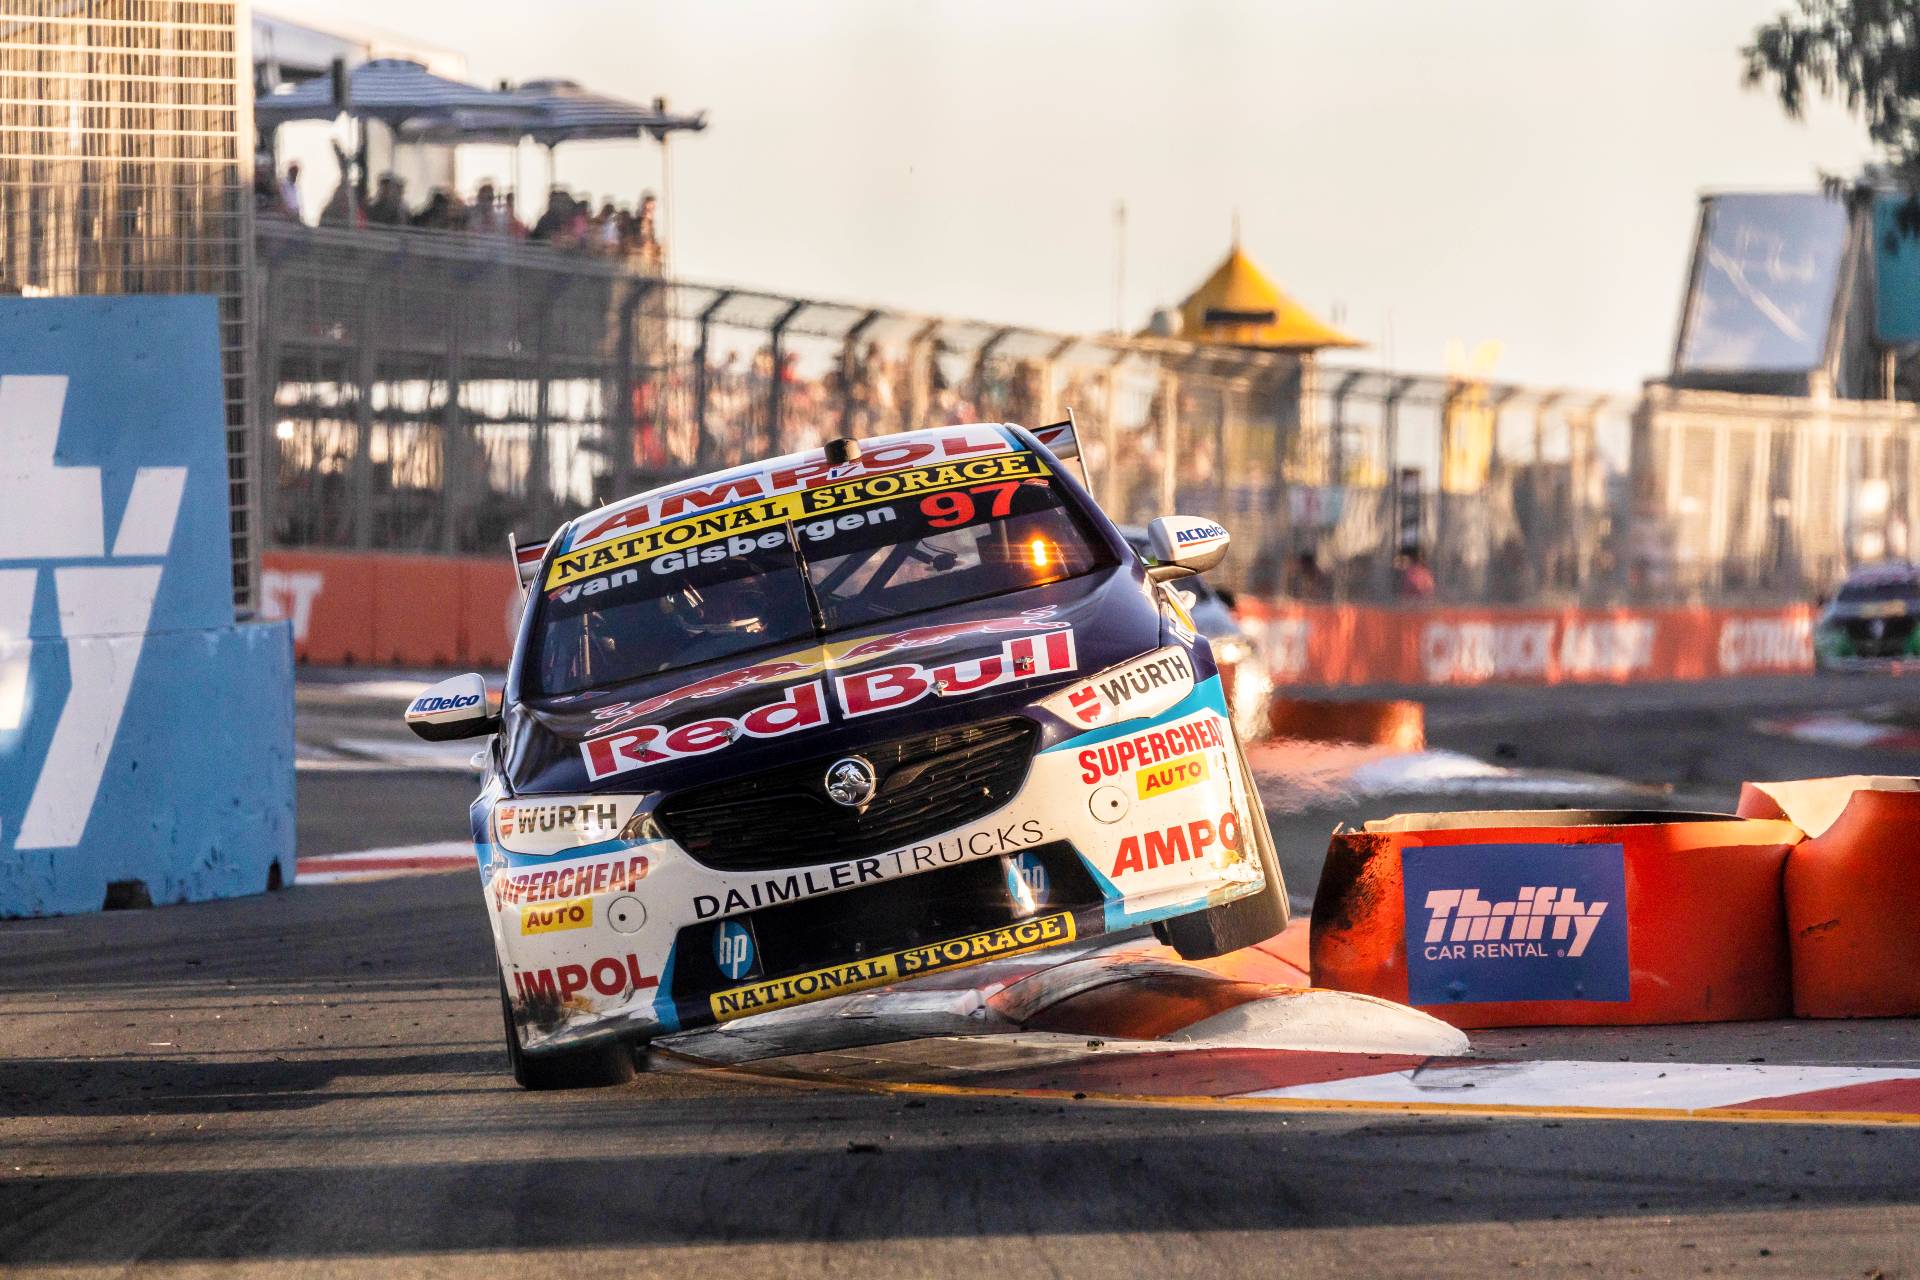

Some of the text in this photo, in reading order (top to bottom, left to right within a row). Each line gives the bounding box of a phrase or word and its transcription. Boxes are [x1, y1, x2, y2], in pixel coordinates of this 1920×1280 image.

[558, 455, 1030, 579] NATIONAL STORAGE
[576, 436, 1006, 545] AMPOL
[919, 481, 1022, 528] 97
[559, 506, 897, 604] van Gisbergen
[411, 694, 479, 712] ACDelco
[1100, 655, 1190, 706] WÜRTH
[1144, 761, 1202, 792] AUTO
[518, 803, 618, 834] WÜRTH
[495, 856, 649, 912] SUPERCHEAP
[693, 820, 1044, 920] DAIMLER TRUCKS
[526, 905, 585, 928] AUTO
[1424, 886, 1609, 957] Thrifty
[718, 921, 747, 979] hp
[718, 916, 1061, 1014] NATIONAL STORAGE
[1424, 942, 1548, 961] CAR RENTAL
